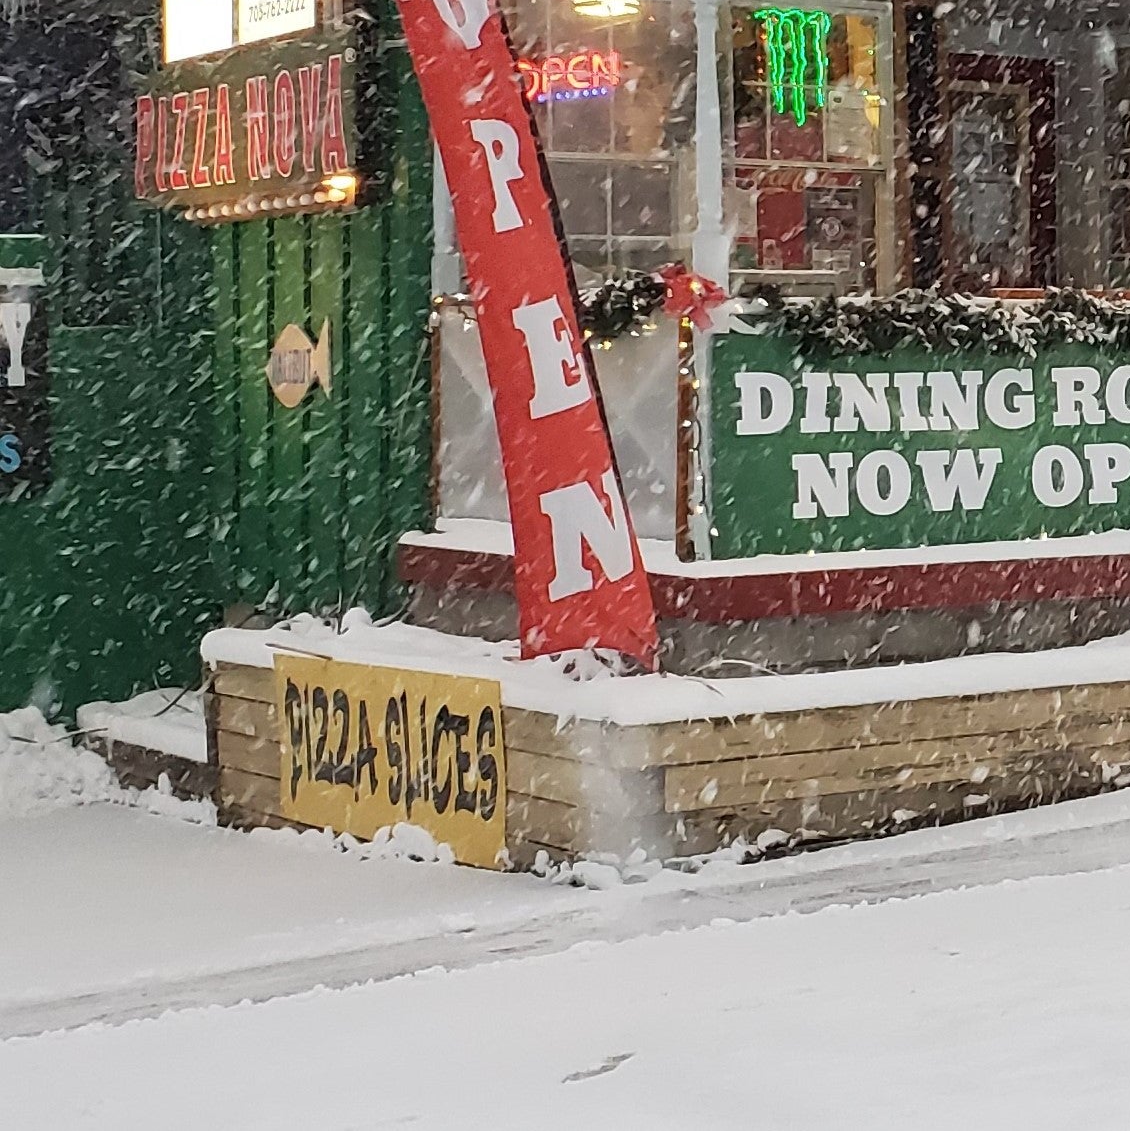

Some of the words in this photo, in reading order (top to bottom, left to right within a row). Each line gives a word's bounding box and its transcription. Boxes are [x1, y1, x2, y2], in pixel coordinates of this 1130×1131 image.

[135, 84, 236, 199] PIZZA
[246, 54, 348, 178] NOVA
[735, 368, 1036, 436] DINING
[792, 447, 1003, 520] NOW
[285, 676, 379, 803] PIZZA
[385, 689, 499, 822] SLICES
